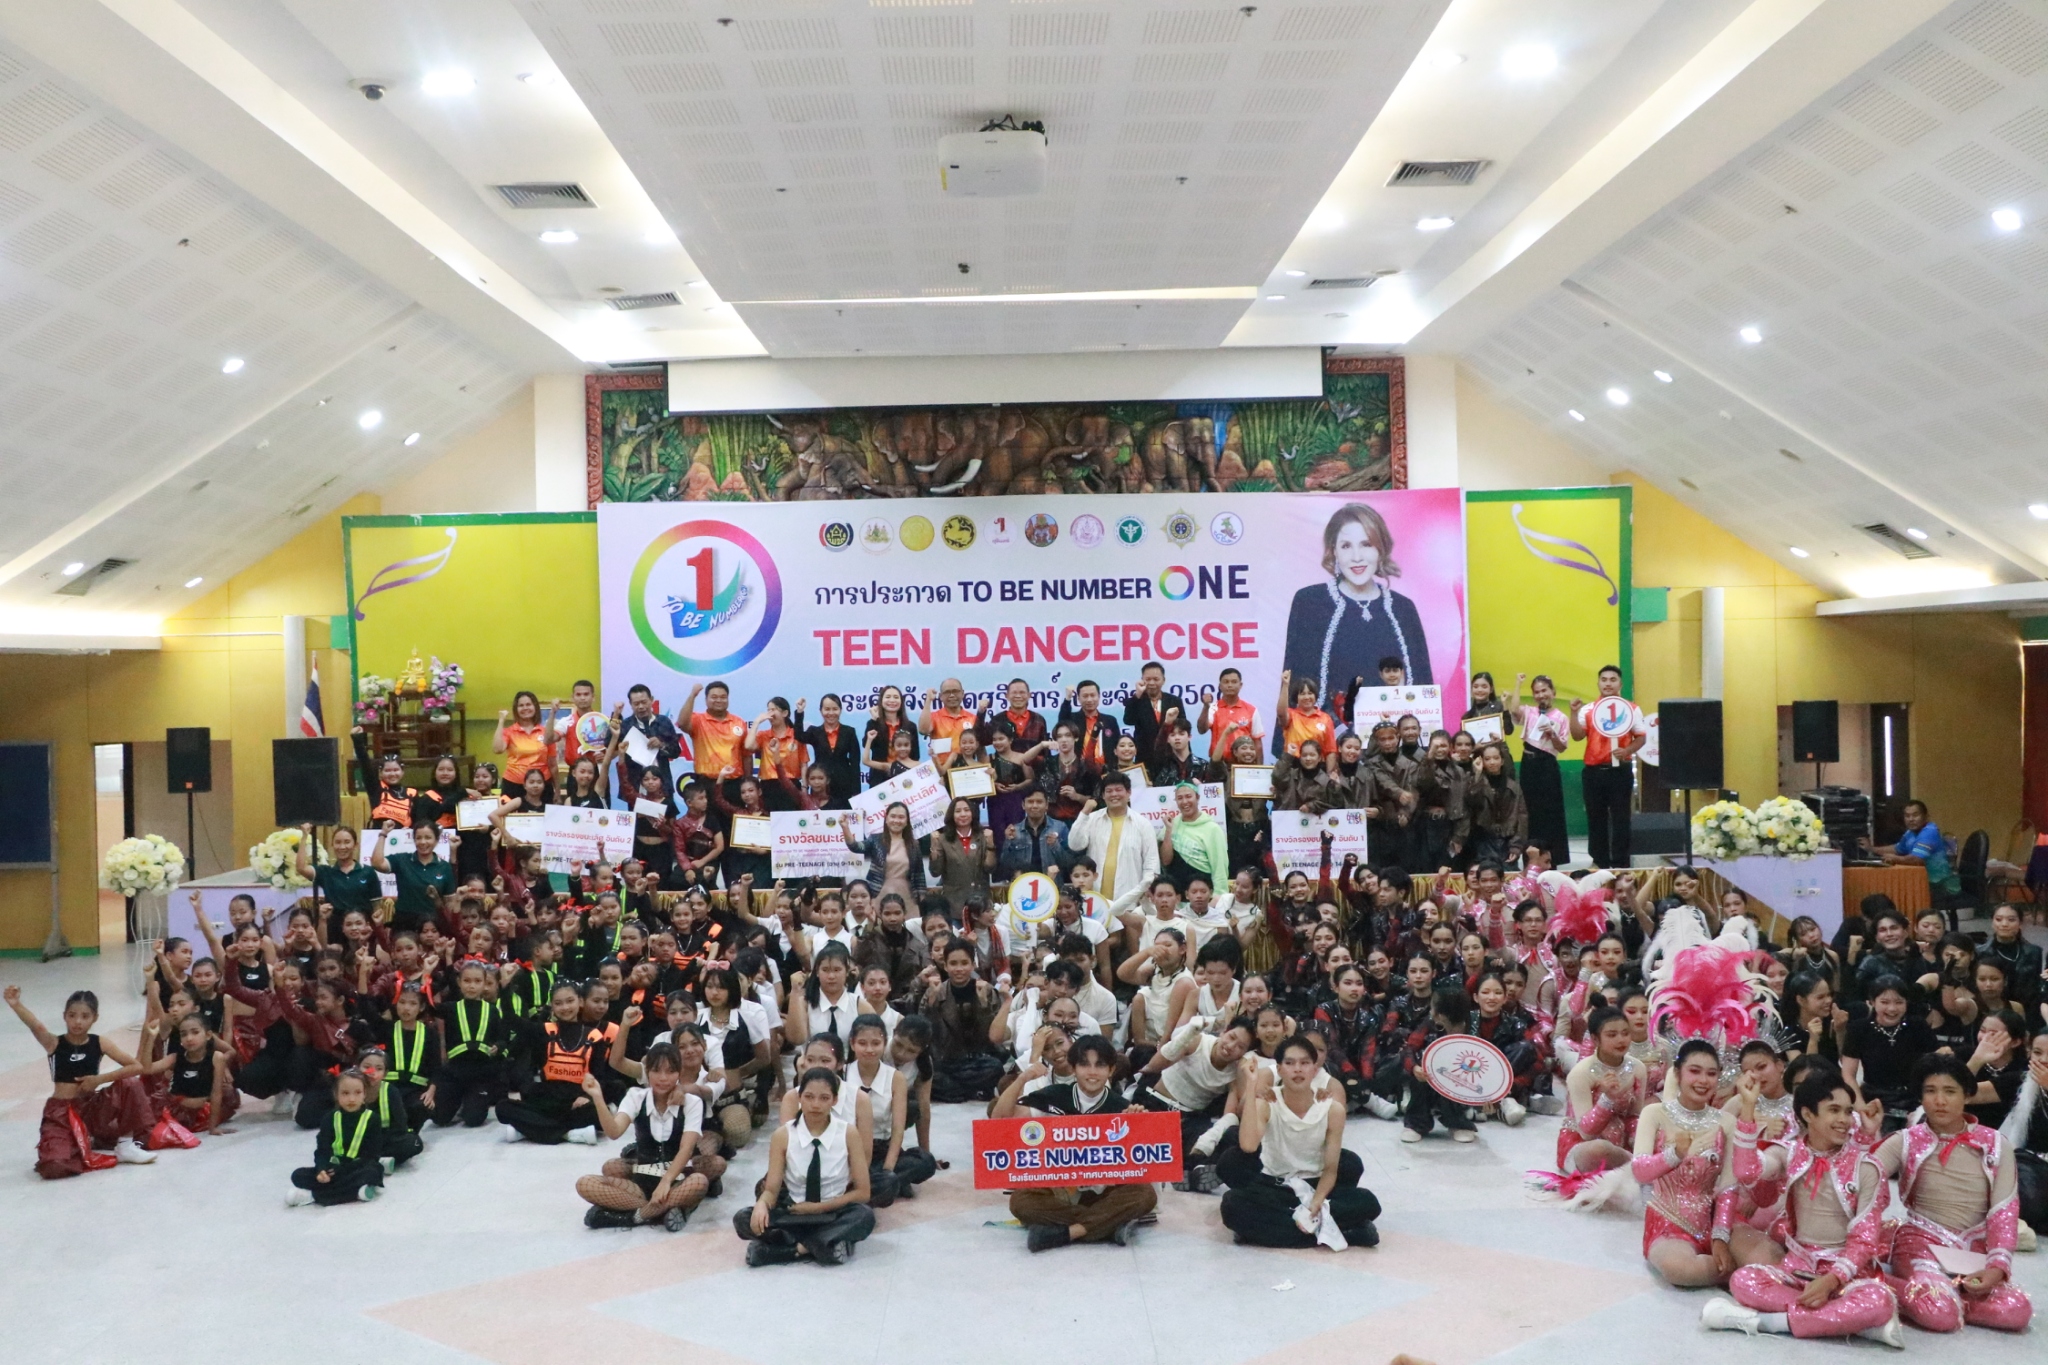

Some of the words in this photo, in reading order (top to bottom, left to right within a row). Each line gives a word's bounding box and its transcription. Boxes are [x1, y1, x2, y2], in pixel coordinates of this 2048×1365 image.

[686, 547, 713, 611] 1
[815, 580, 951, 605] การประกวด
[957, 580, 993, 602] TO
[1000, 580, 1034, 602] BE
[1041, 578, 1152, 601] NUMBER
[1159, 565, 1250, 601] ONE
[680, 611, 705, 629] BE
[813, 628, 931, 666] TEEN
[957, 622, 1259, 664] DANCERCISE
[1607, 702, 1617, 723] 1
[1028, 879, 1039, 902] 1
[548, 1065, 582, 1077] Fashion
[1052, 1126, 1100, 1142] ชมรม
[983, 1150, 1010, 1170] TO
[1015, 1149, 1041, 1169] BE
[1045, 1145, 1127, 1168] NUMBER
[1131, 1143, 1173, 1164] ONE
